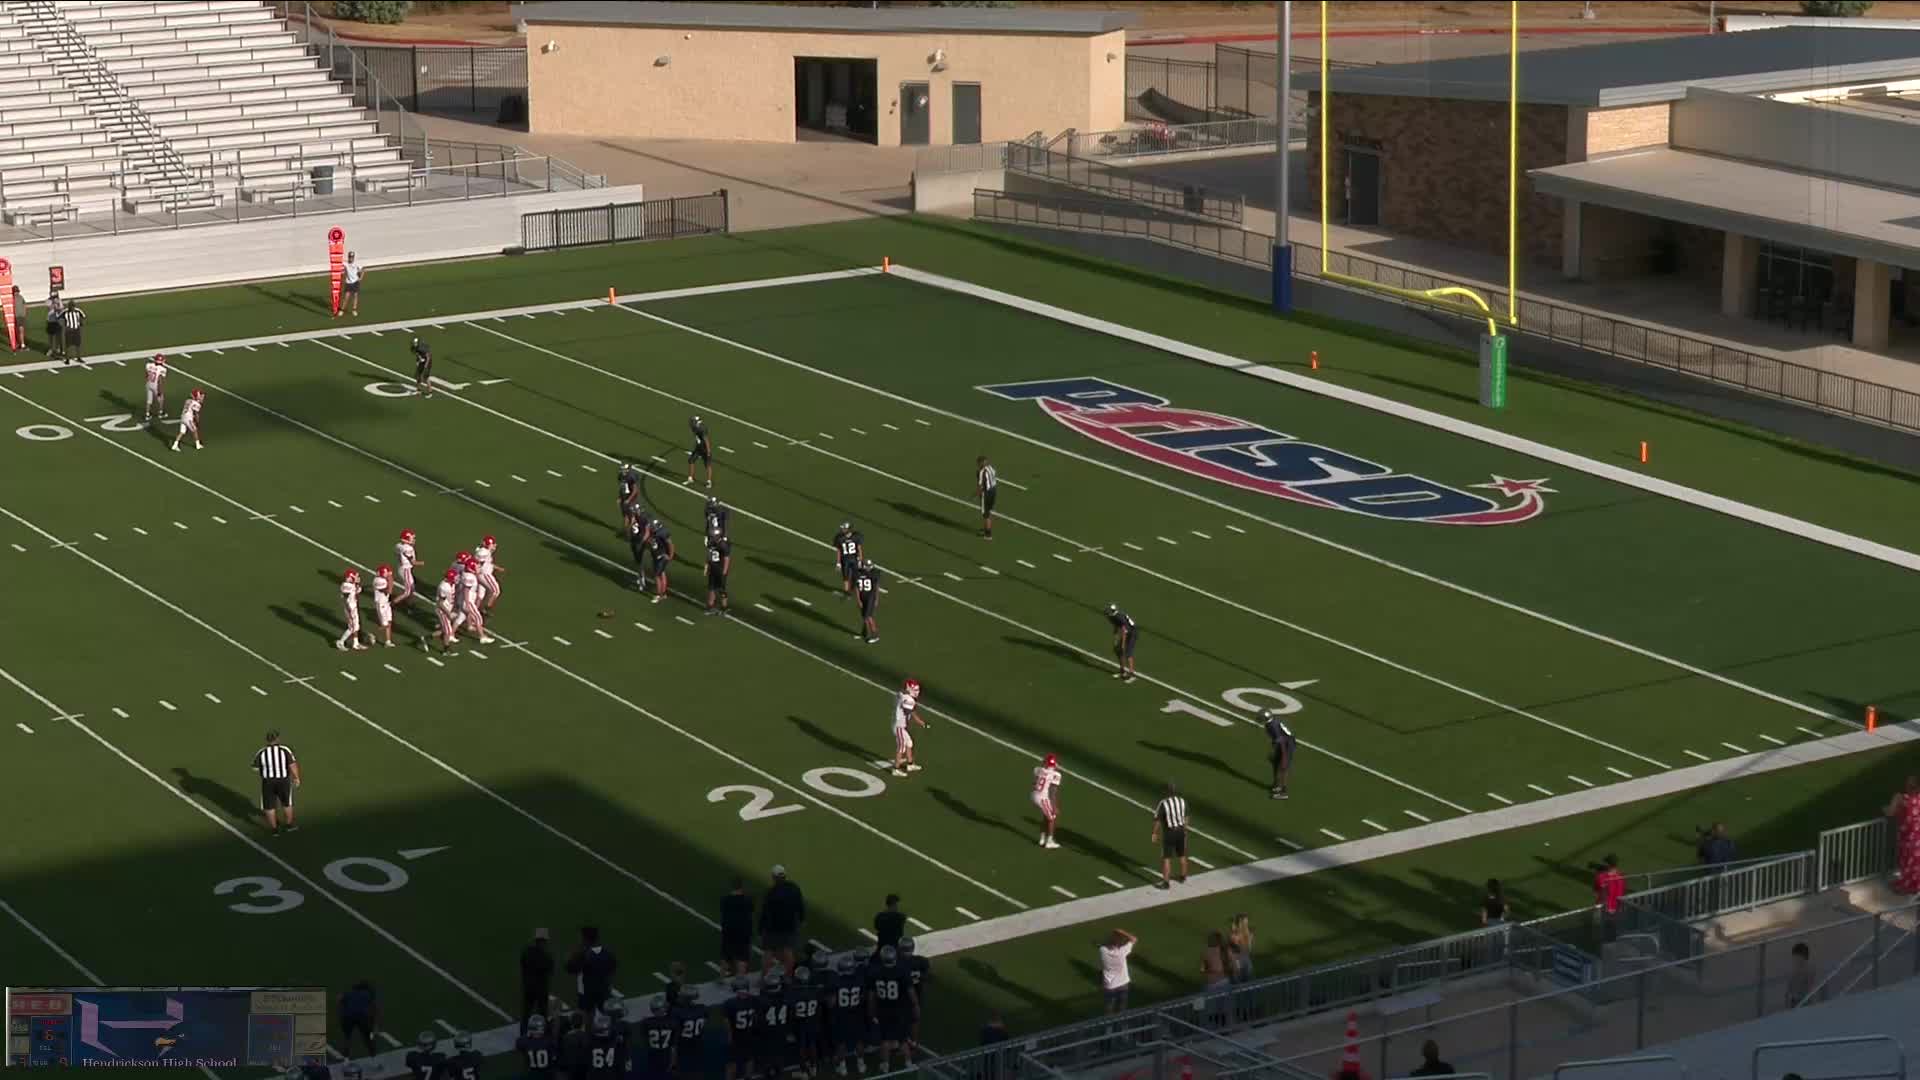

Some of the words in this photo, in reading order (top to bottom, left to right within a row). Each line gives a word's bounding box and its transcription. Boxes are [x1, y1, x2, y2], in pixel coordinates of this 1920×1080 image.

[15, 413, 150, 441] 20
[841, 541, 857, 555] 12
[1160, 687, 1303, 727] 10
[707, 766, 887, 821] 20
[213, 856, 409, 915] 30
[765, 1004, 788, 1026] 44
[795, 1000, 819, 1018] 28
[648, 1029, 673, 1049] 27
[681, 1017, 704, 1039] 20
[527, 1049, 549, 1069] 10
[592, 1047, 615, 1069] 64
[420, 1065, 433, 1080] 7
